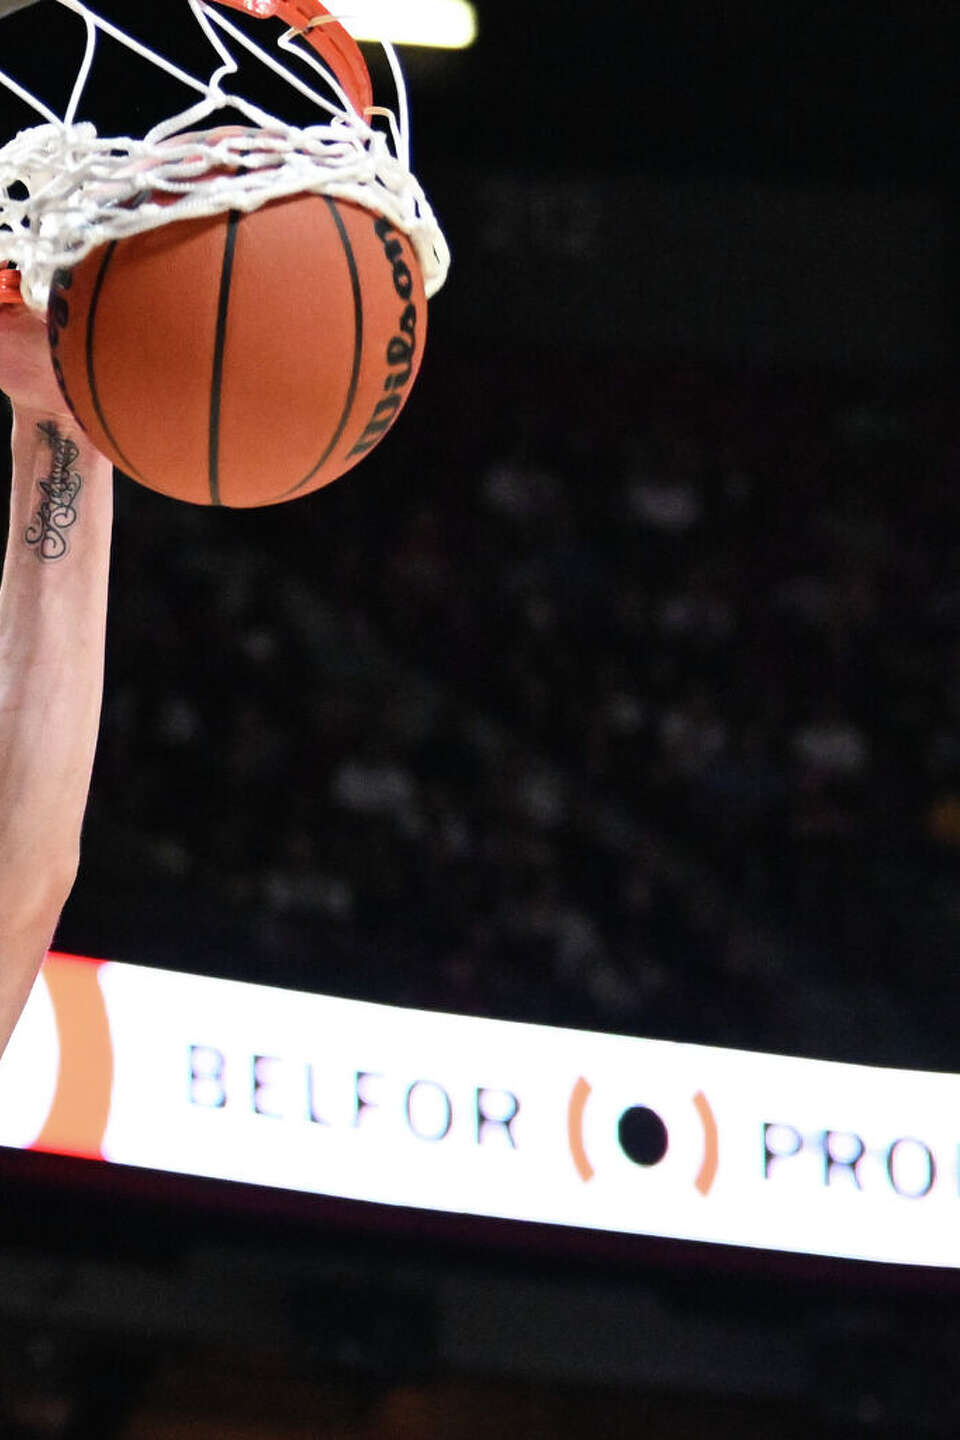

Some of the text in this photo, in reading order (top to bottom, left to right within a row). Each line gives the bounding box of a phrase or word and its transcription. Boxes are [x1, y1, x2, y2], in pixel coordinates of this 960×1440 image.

[346, 217, 417, 460] Wilson
[189, 1044, 960, 1200] BELFOR PRO
